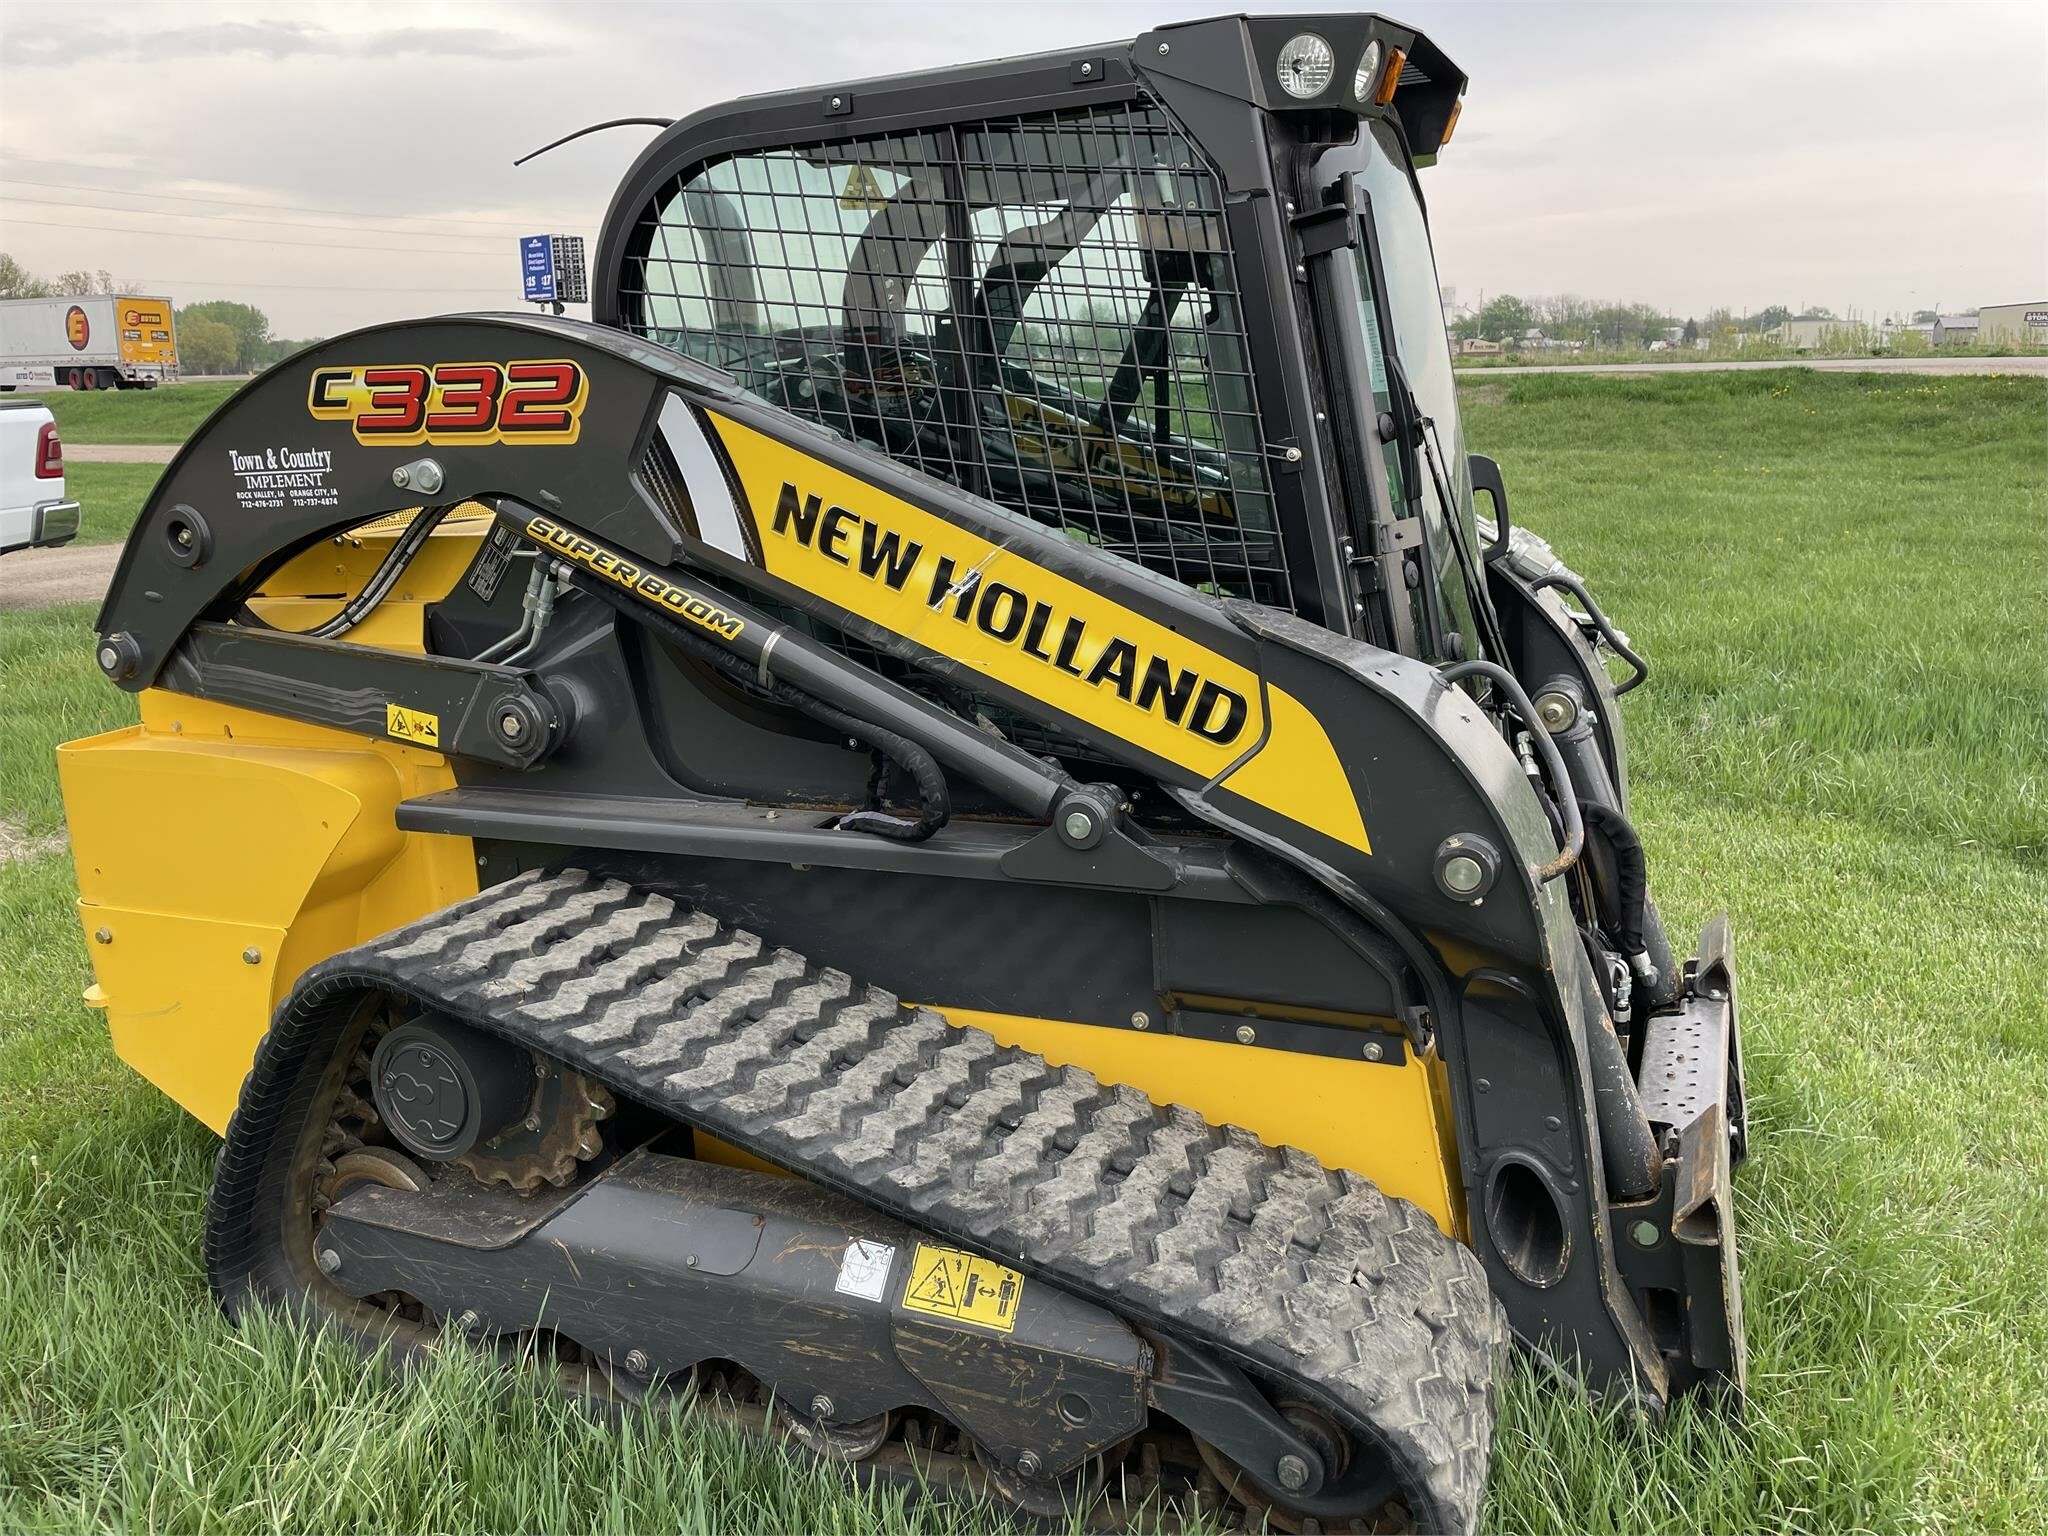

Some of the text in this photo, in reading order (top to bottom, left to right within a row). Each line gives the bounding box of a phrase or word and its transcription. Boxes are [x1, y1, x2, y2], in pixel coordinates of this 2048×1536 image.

[310, 363, 583, 434] C332
[228, 447, 331, 473] Town & Country
[245, 473, 323, 489] IMPLEMENT
[253, 491, 277, 499] VALLEY,
[277, 490, 285, 498] IA
[289, 488, 338, 497] ORANGE CITY, IA
[241, 500, 284, 508] 712-476-2731
[293, 498, 338, 506] 712-737-4874
[772, 480, 1249, 745] NEW HOLLAND
